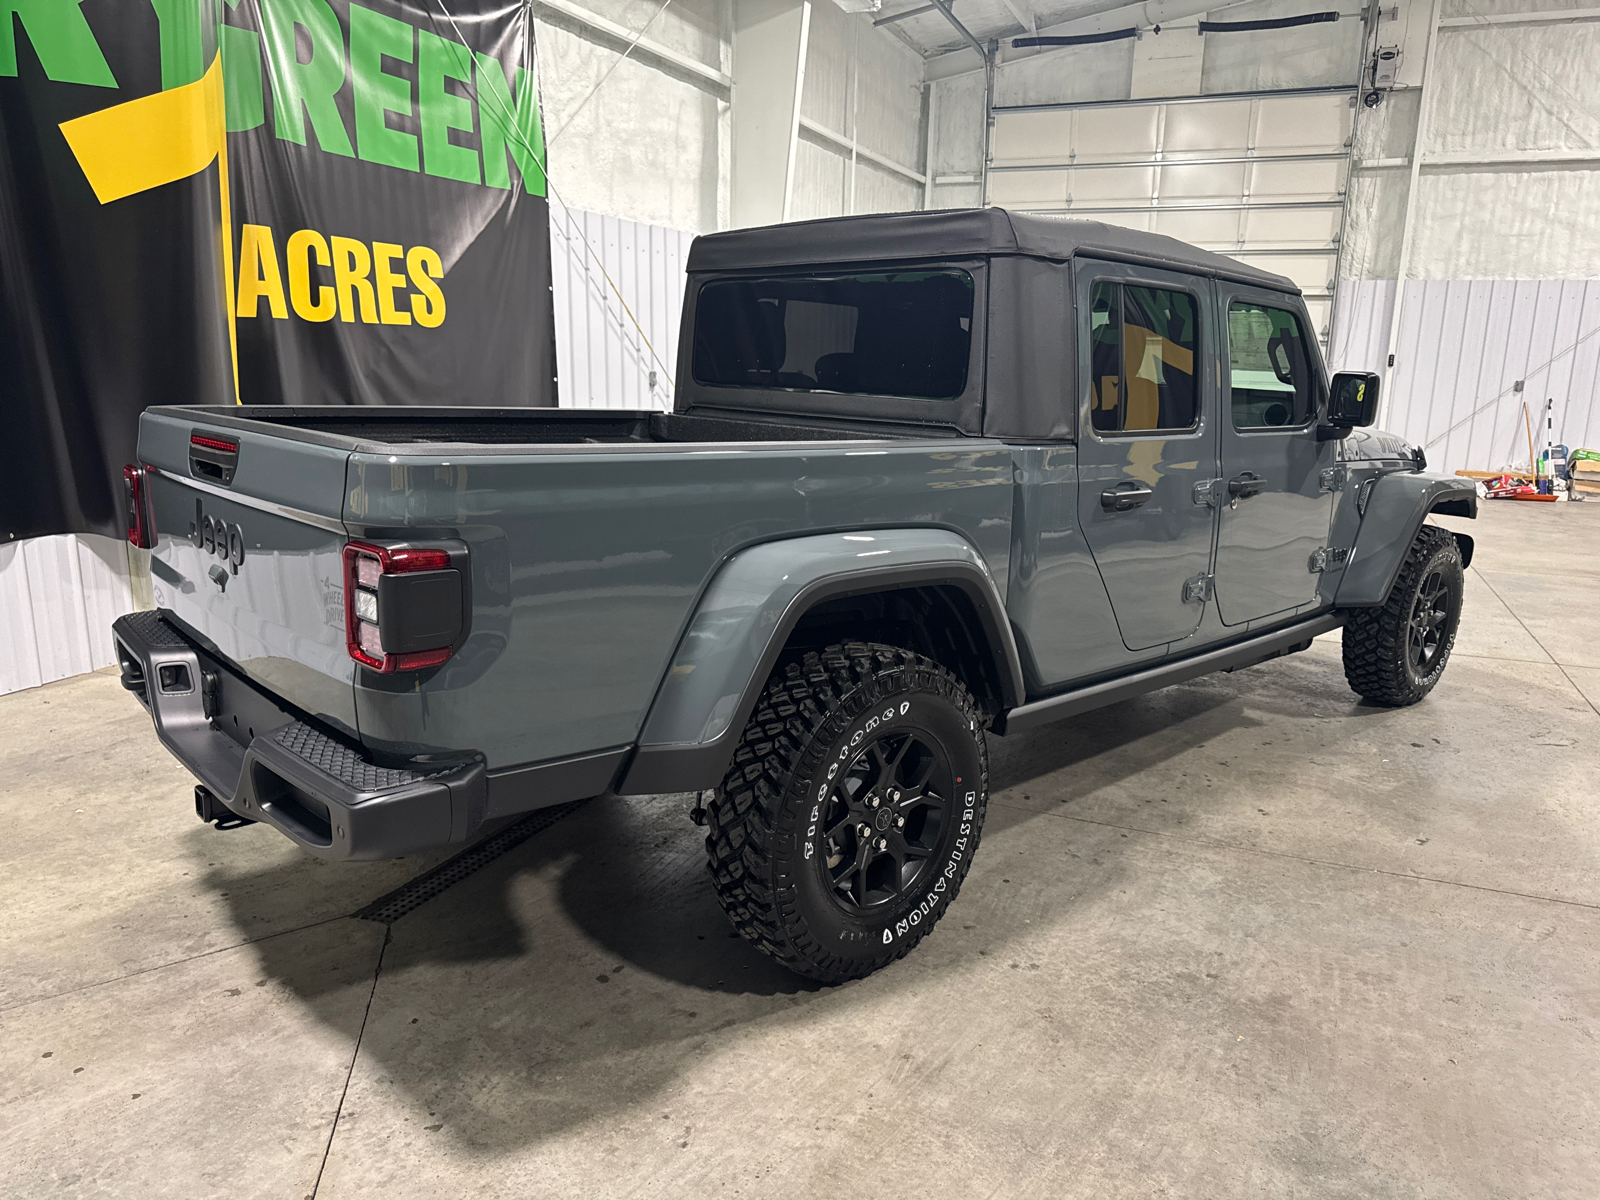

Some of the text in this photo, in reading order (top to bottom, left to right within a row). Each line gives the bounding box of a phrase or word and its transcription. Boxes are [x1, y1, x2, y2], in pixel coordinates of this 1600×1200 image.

[236, 223, 446, 328] ACRES
[187, 497, 245, 576] Jeep
[323, 590, 345, 608] WHEEL
[325, 607, 345, 626] DRIVE
[895, 791, 975, 937] DESTINATION
